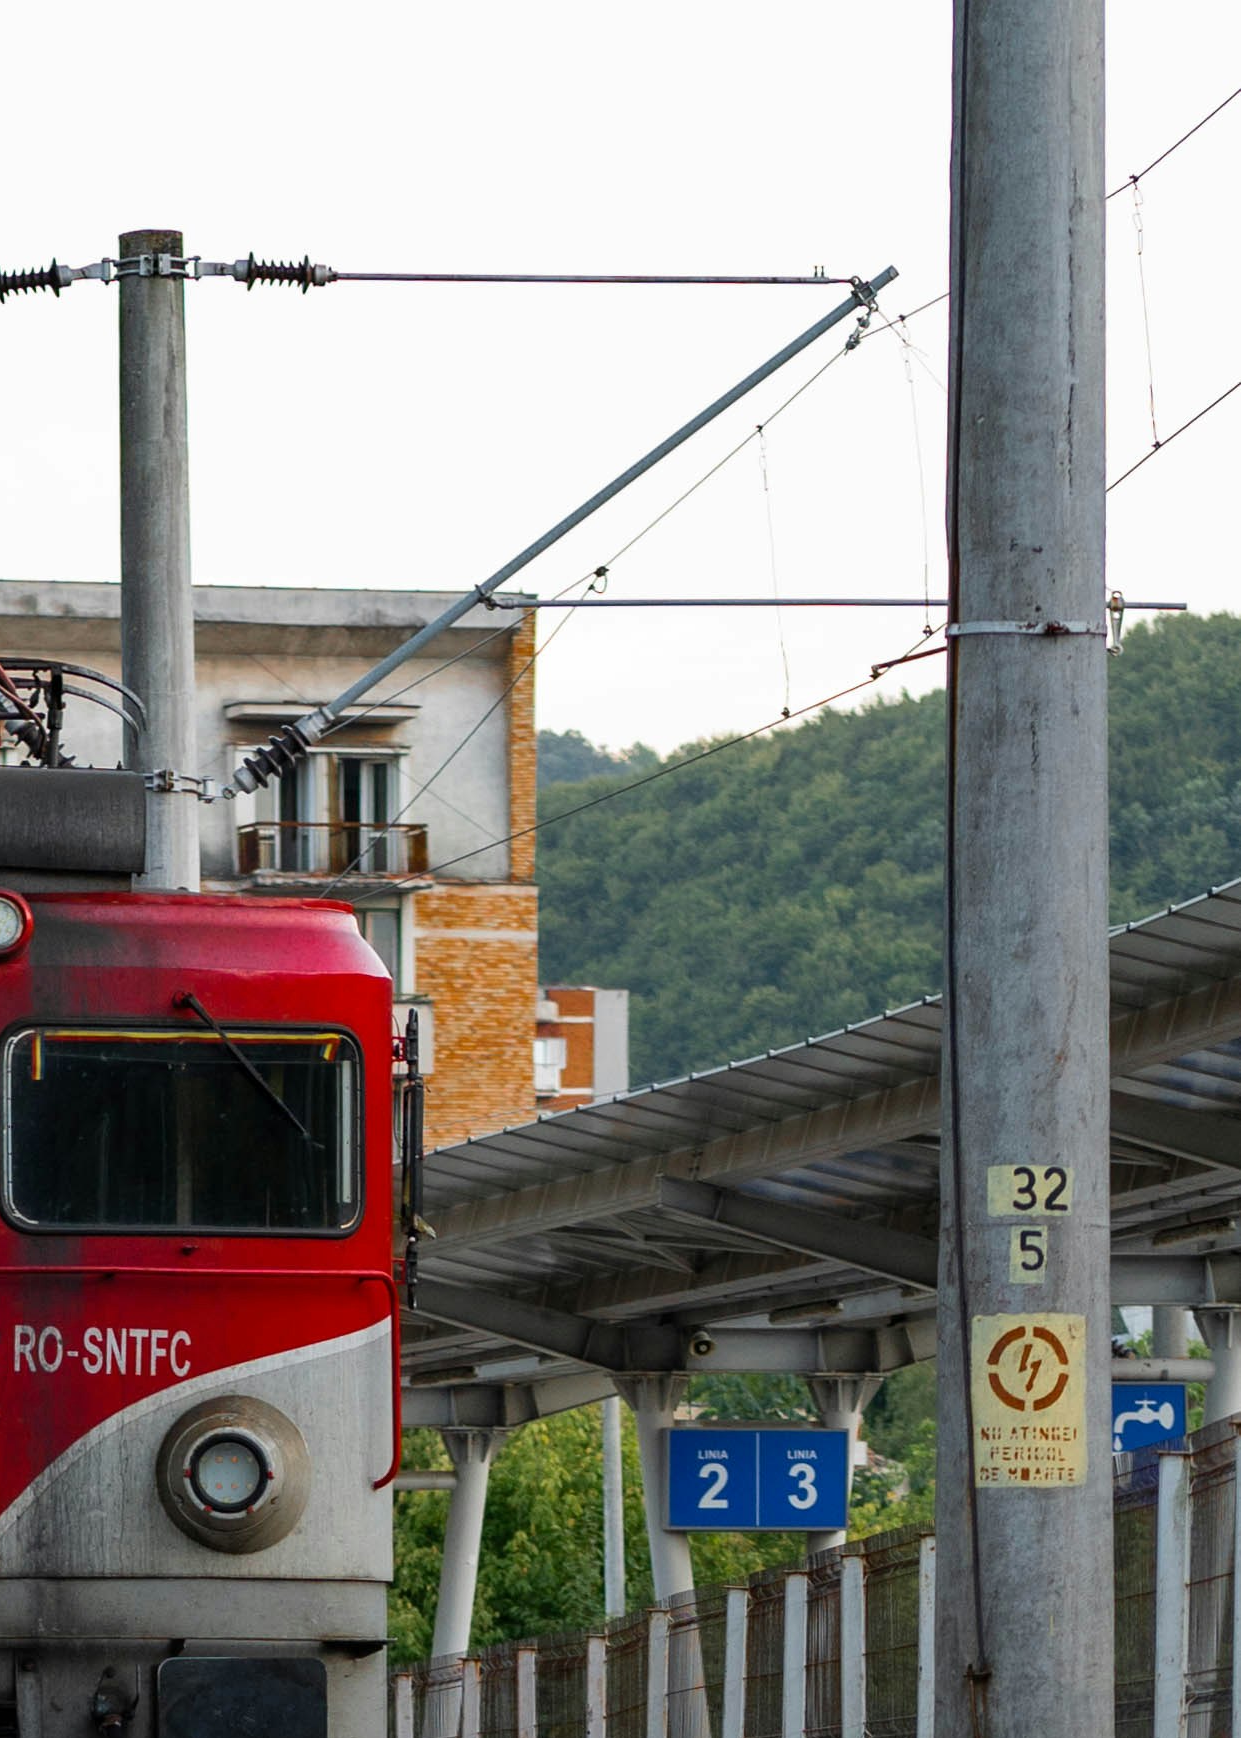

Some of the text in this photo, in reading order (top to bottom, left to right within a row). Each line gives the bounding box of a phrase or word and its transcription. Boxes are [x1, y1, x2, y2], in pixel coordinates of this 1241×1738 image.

[1013, 1167, 1068, 1211] 32
[1020, 1230, 1045, 1271] 5
[14, 1324, 192, 1377] RO-SNTFC
[697, 1450, 729, 1460] LINIA
[787, 1450, 818, 1460] LINIA
[697, 1463, 729, 1509] 2
[787, 1463, 818, 1510] 3
